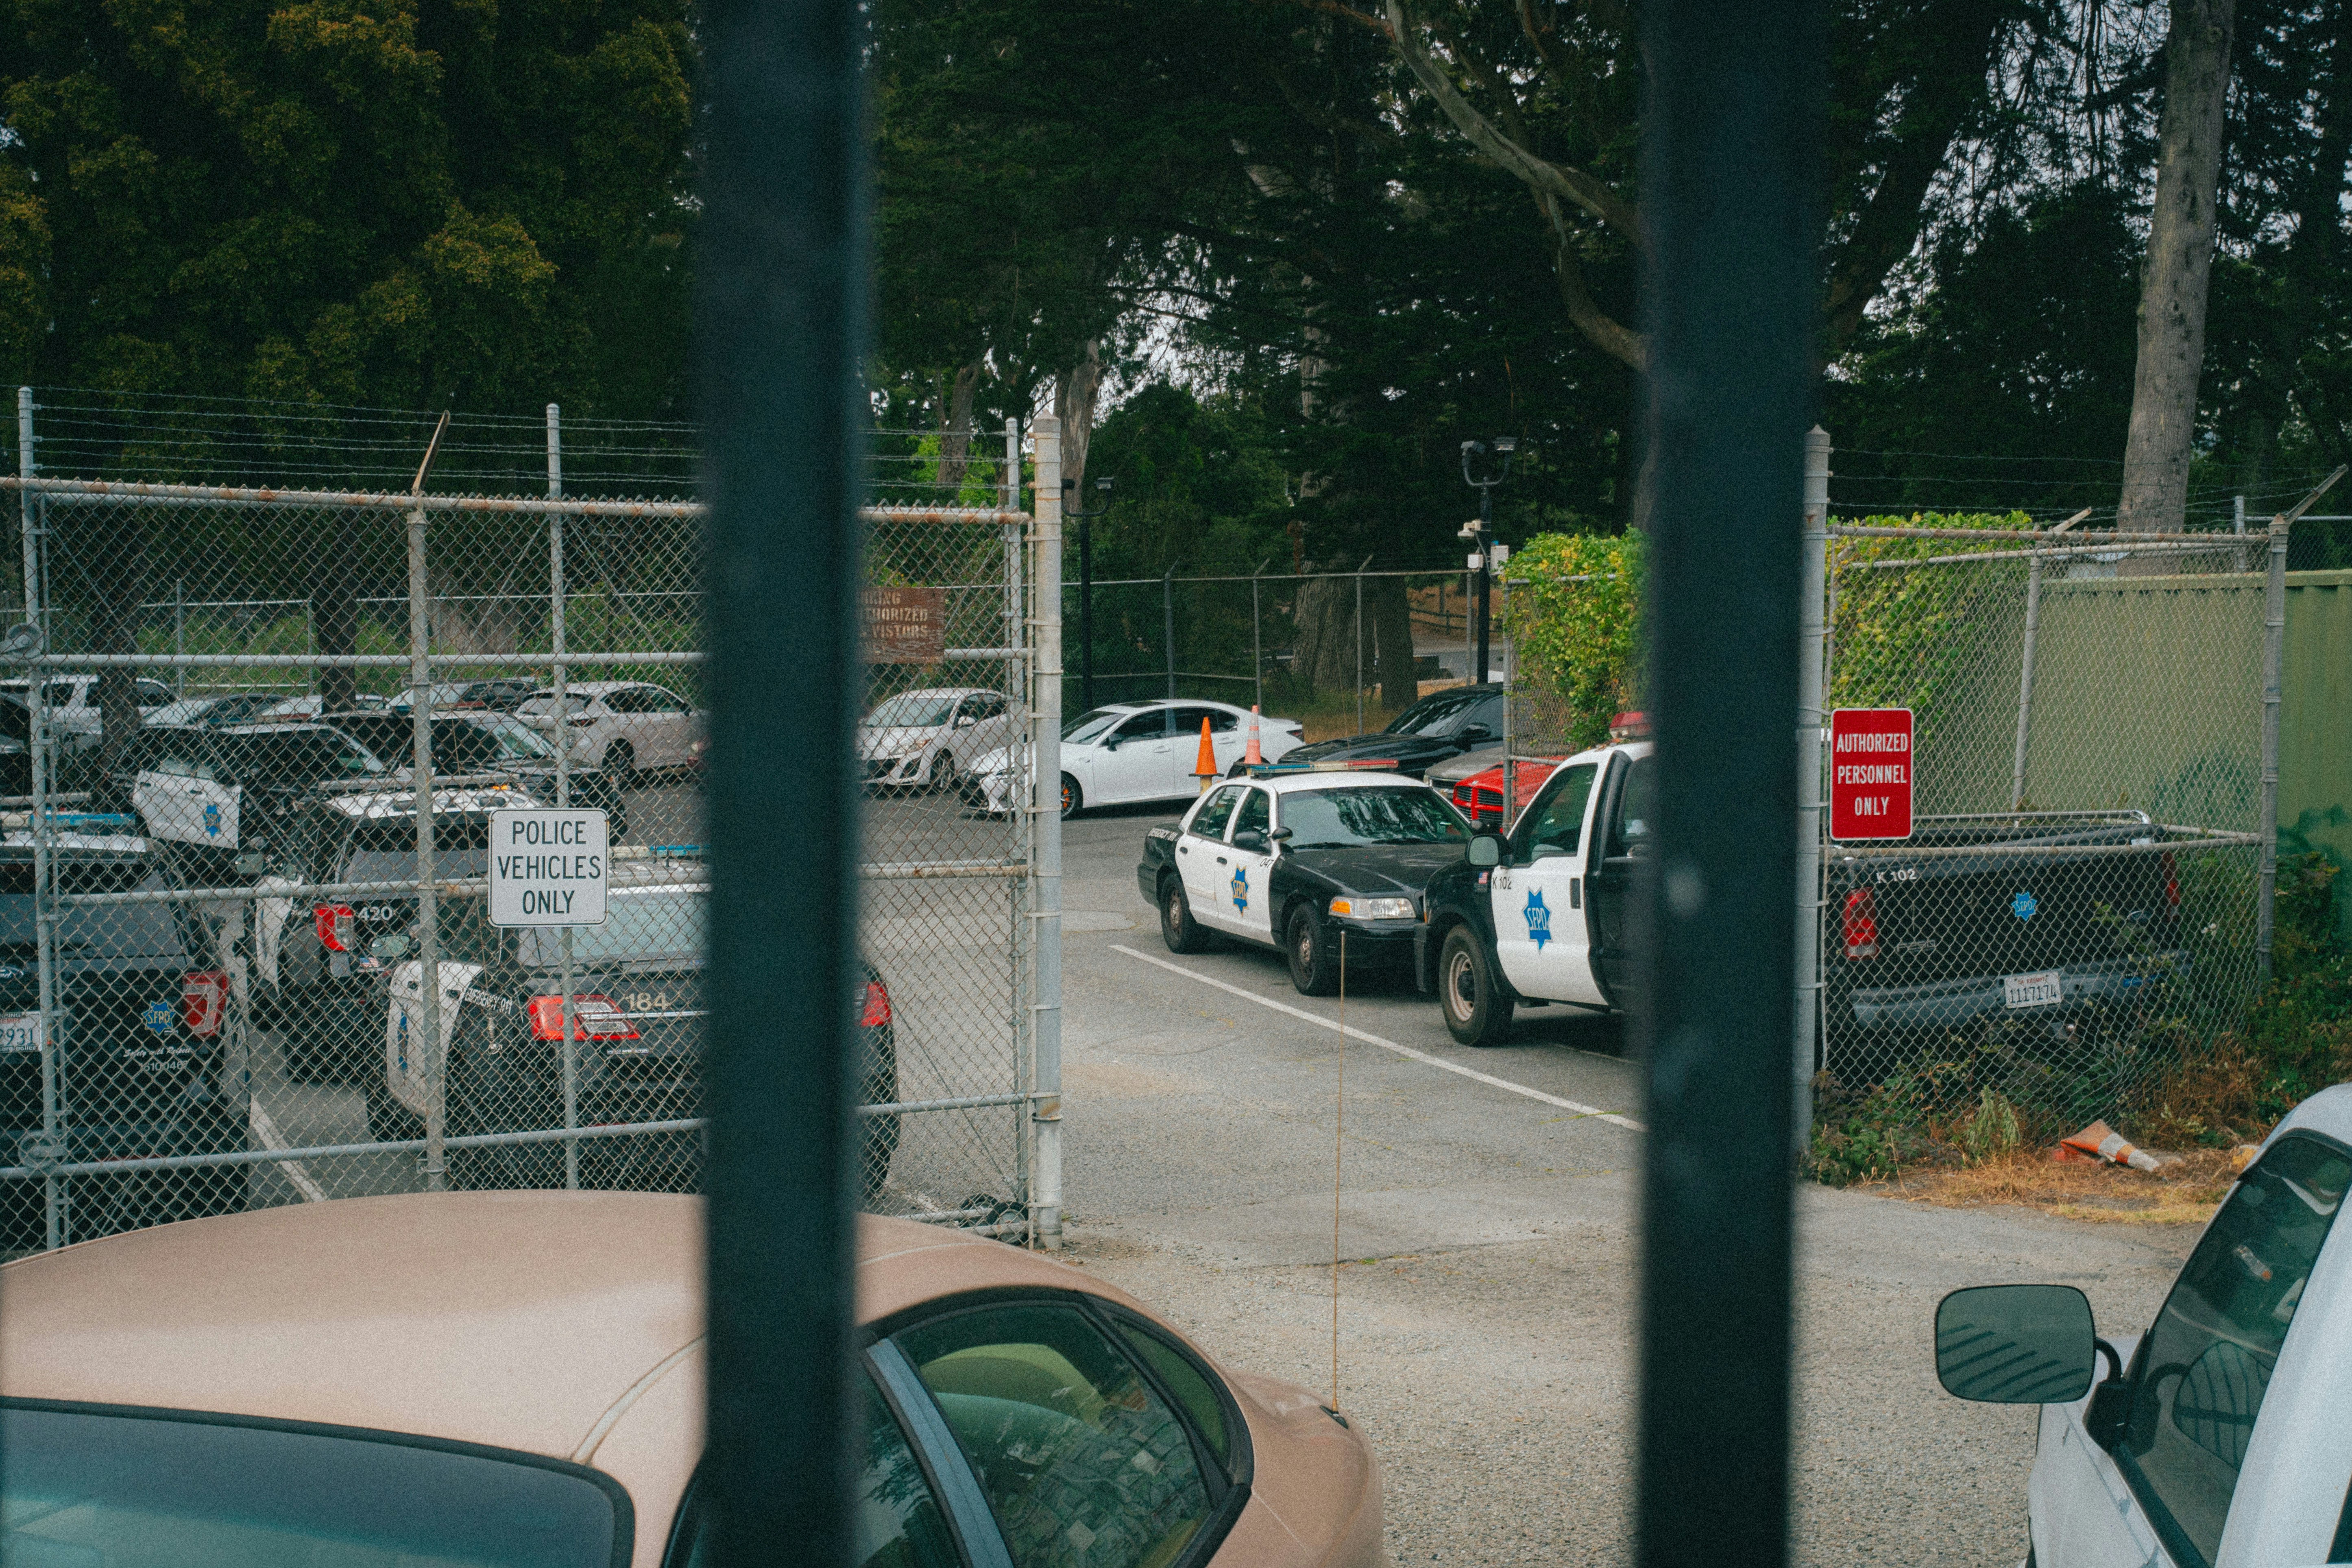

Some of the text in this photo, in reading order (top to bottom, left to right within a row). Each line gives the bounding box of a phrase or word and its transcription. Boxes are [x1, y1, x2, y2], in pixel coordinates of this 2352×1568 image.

[1836, 733, 1908, 752] AUTHORIZED
[1838, 765, 1907, 784] PERSONNEL
[1855, 796, 1889, 816] ONLY
[512, 820, 586, 845] POLICE
[497, 855, 601, 879] VEHICLES
[1260, 858, 1274, 868] 047
[1492, 876, 1512, 890] K 102
[1876, 869, 1917, 883] K 102
[522, 890, 575, 914] ONLY
[358, 906, 393, 921] 420
[625, 992, 670, 1011] 184
[2010, 984, 2057, 1003] 1117174
